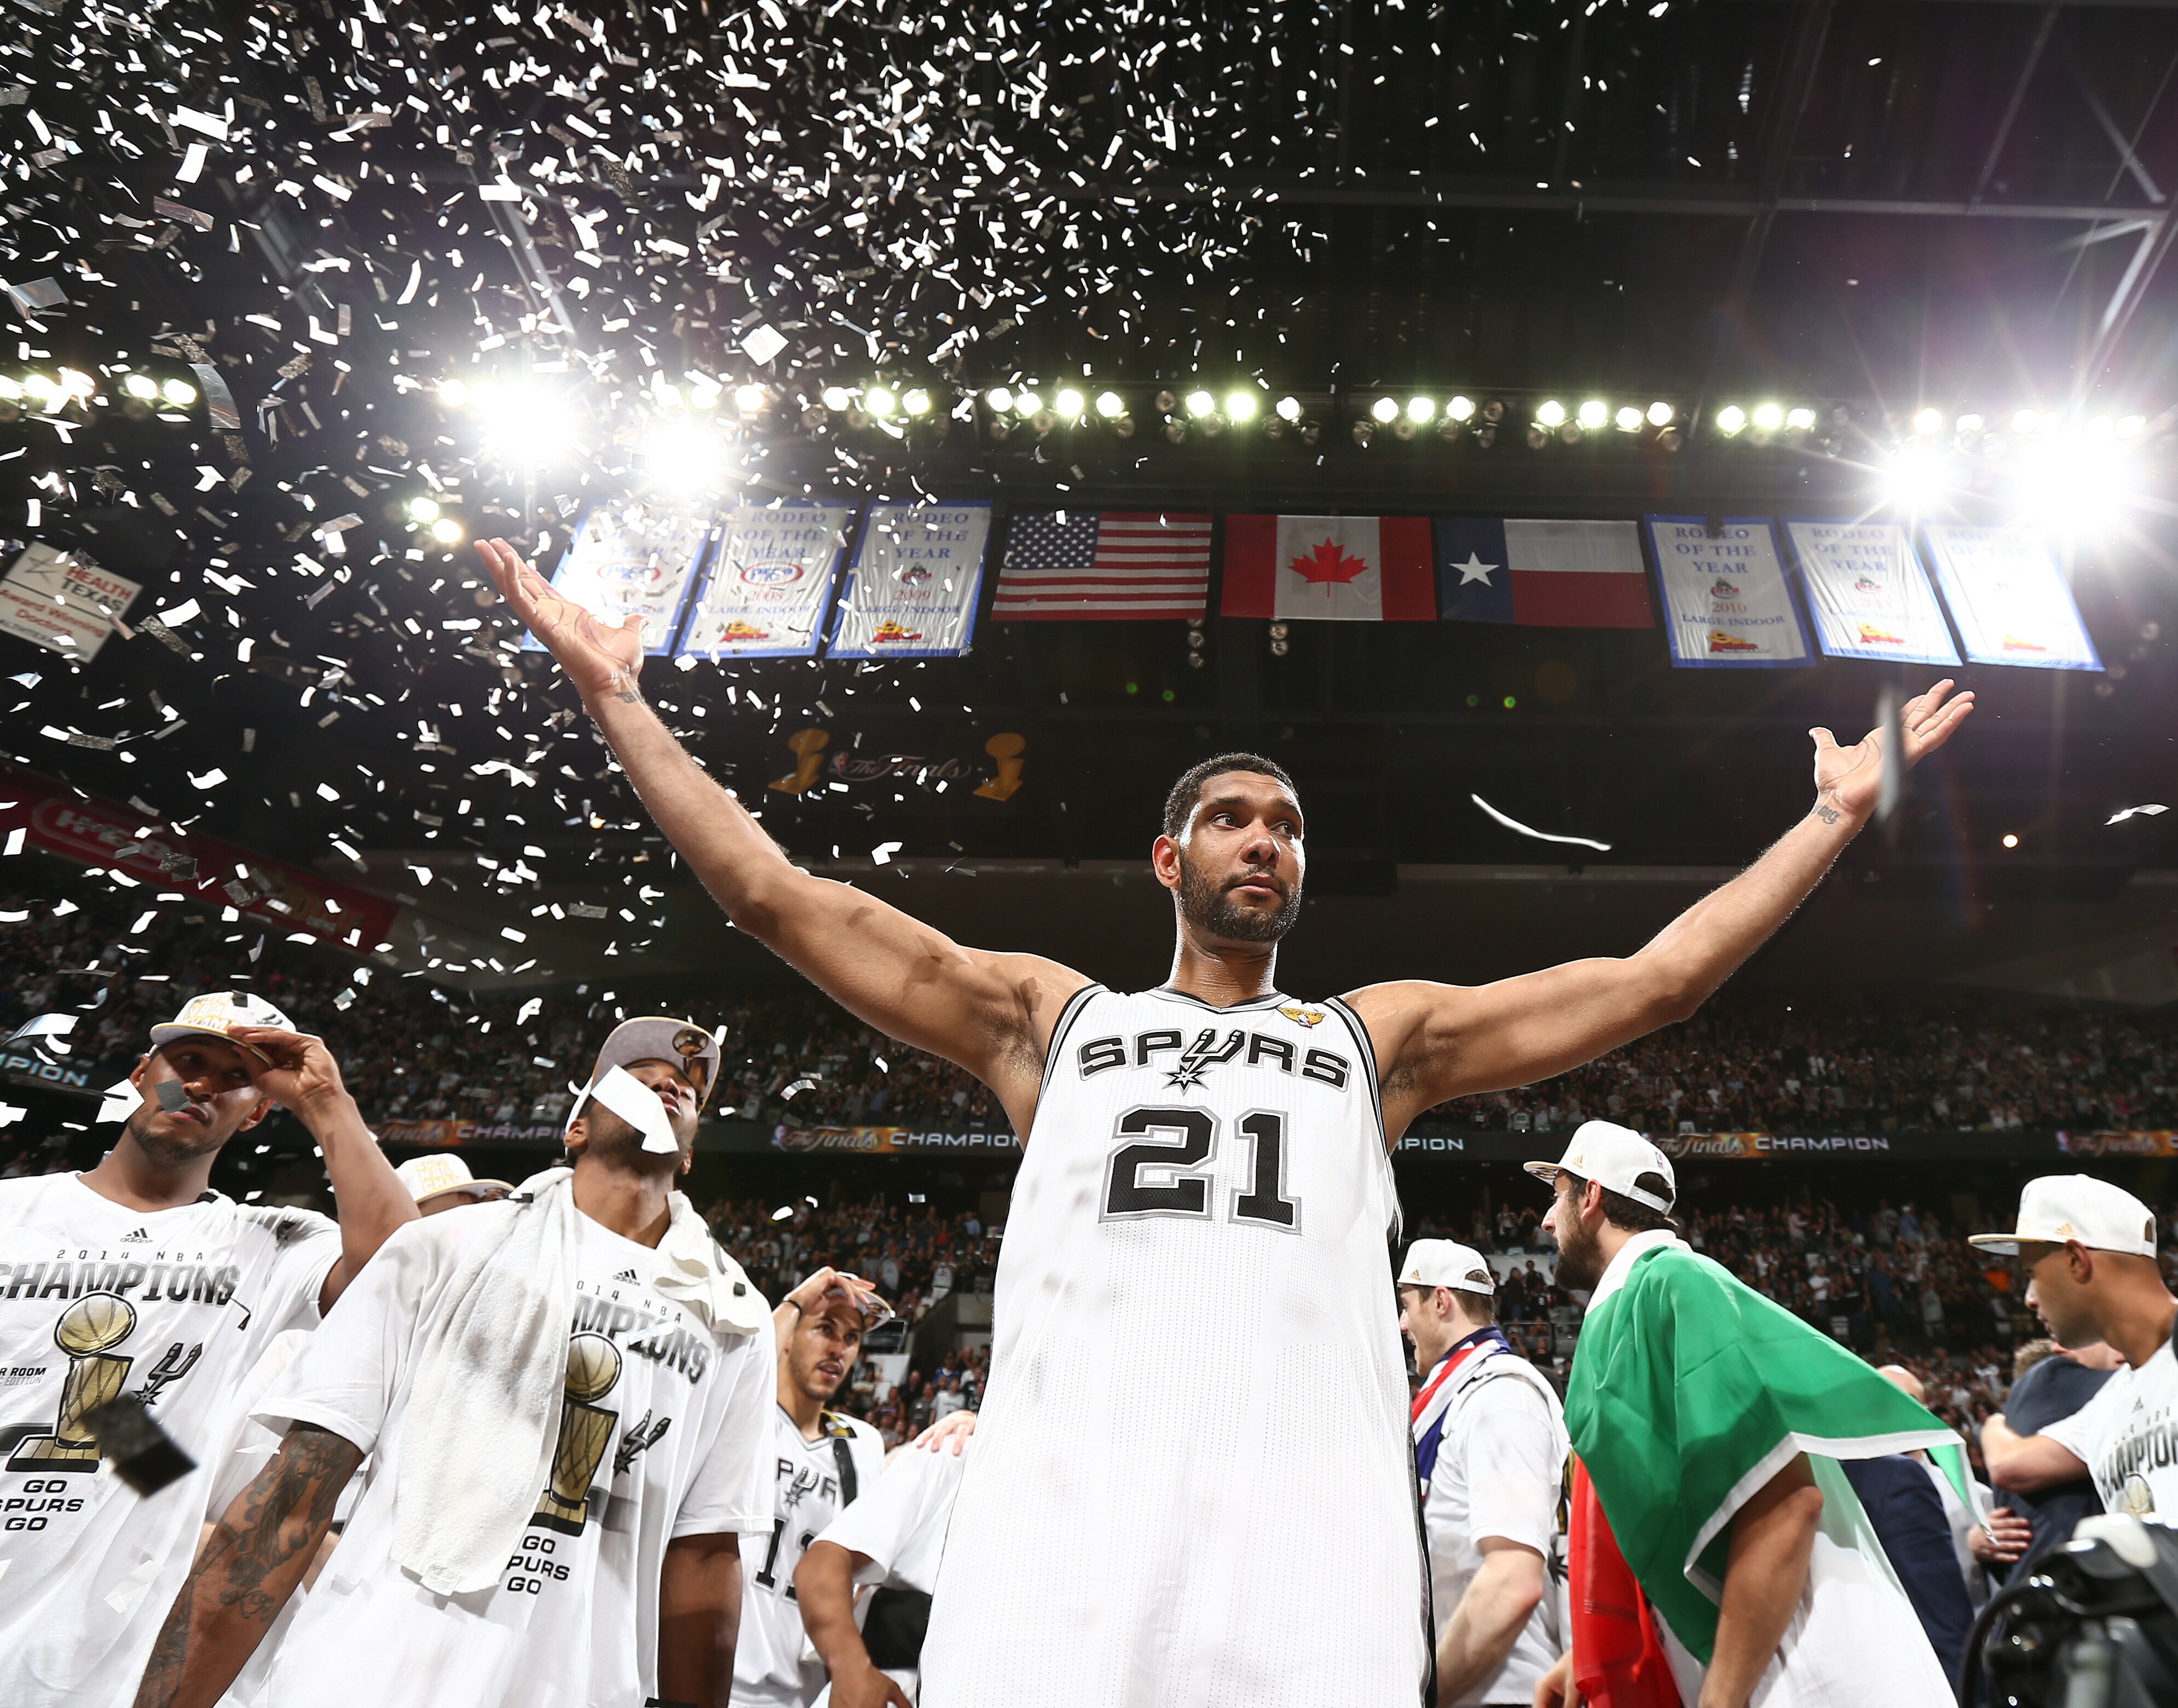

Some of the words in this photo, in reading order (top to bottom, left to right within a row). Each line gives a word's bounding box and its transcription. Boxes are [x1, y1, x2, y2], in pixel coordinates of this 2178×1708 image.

[752, 512, 827, 523] RODEO
[893, 512, 969, 523] RODEO
[744, 529, 772, 540] OF
[781, 529, 823, 541] THE
[923, 530, 968, 541] THE
[1676, 527, 1749, 539] ROEO
[751, 548, 807, 558] YEAR
[896, 548, 950, 558] YEAR
[1676, 543, 1703, 555] OF
[1710, 545, 1757, 556] THE
[1850, 544, 1894, 555] THE
[1692, 561, 1748, 573] YEAR
[1831, 559, 1887, 571] YEAR
[66, 567, 133, 600] HEALTH
[61, 577, 125, 612] TEXAS
[893, 589, 931, 601] 2009
[756, 605, 811, 614] INDOOR
[857, 605, 898, 614] LARGE
[904, 605, 960, 614] INDOOR
[1712, 602, 1747, 613] 2010
[48, 607, 106, 638] Winning
[1683, 614, 1725, 625] LARGE
[1729, 615, 1785, 626] INDOOR
[1078, 1028, 1351, 1095] SPURS
[457, 1125, 565, 1140] CHAMPI
[806, 1126, 876, 1151] Finals
[1399, 1138, 1464, 1151] PION
[1675, 1133, 1748, 1158] Finals
[1754, 1136, 1890, 1151] CHAMPION
[1099, 1104, 1302, 1235] 21
[56, 1249, 129, 1260] 2014
[156, 1251, 203, 1262] NBA
[643, 1299, 681, 1324] NBA
[10, 1367, 47, 1376] ROOM
[4, 1376, 43, 1386] EDITION
[23, 1480, 68, 1493] GO
[4, 1517, 48, 1531] GO
[522, 1535, 556, 1555] GO
[506, 1576, 542, 1595] GO
